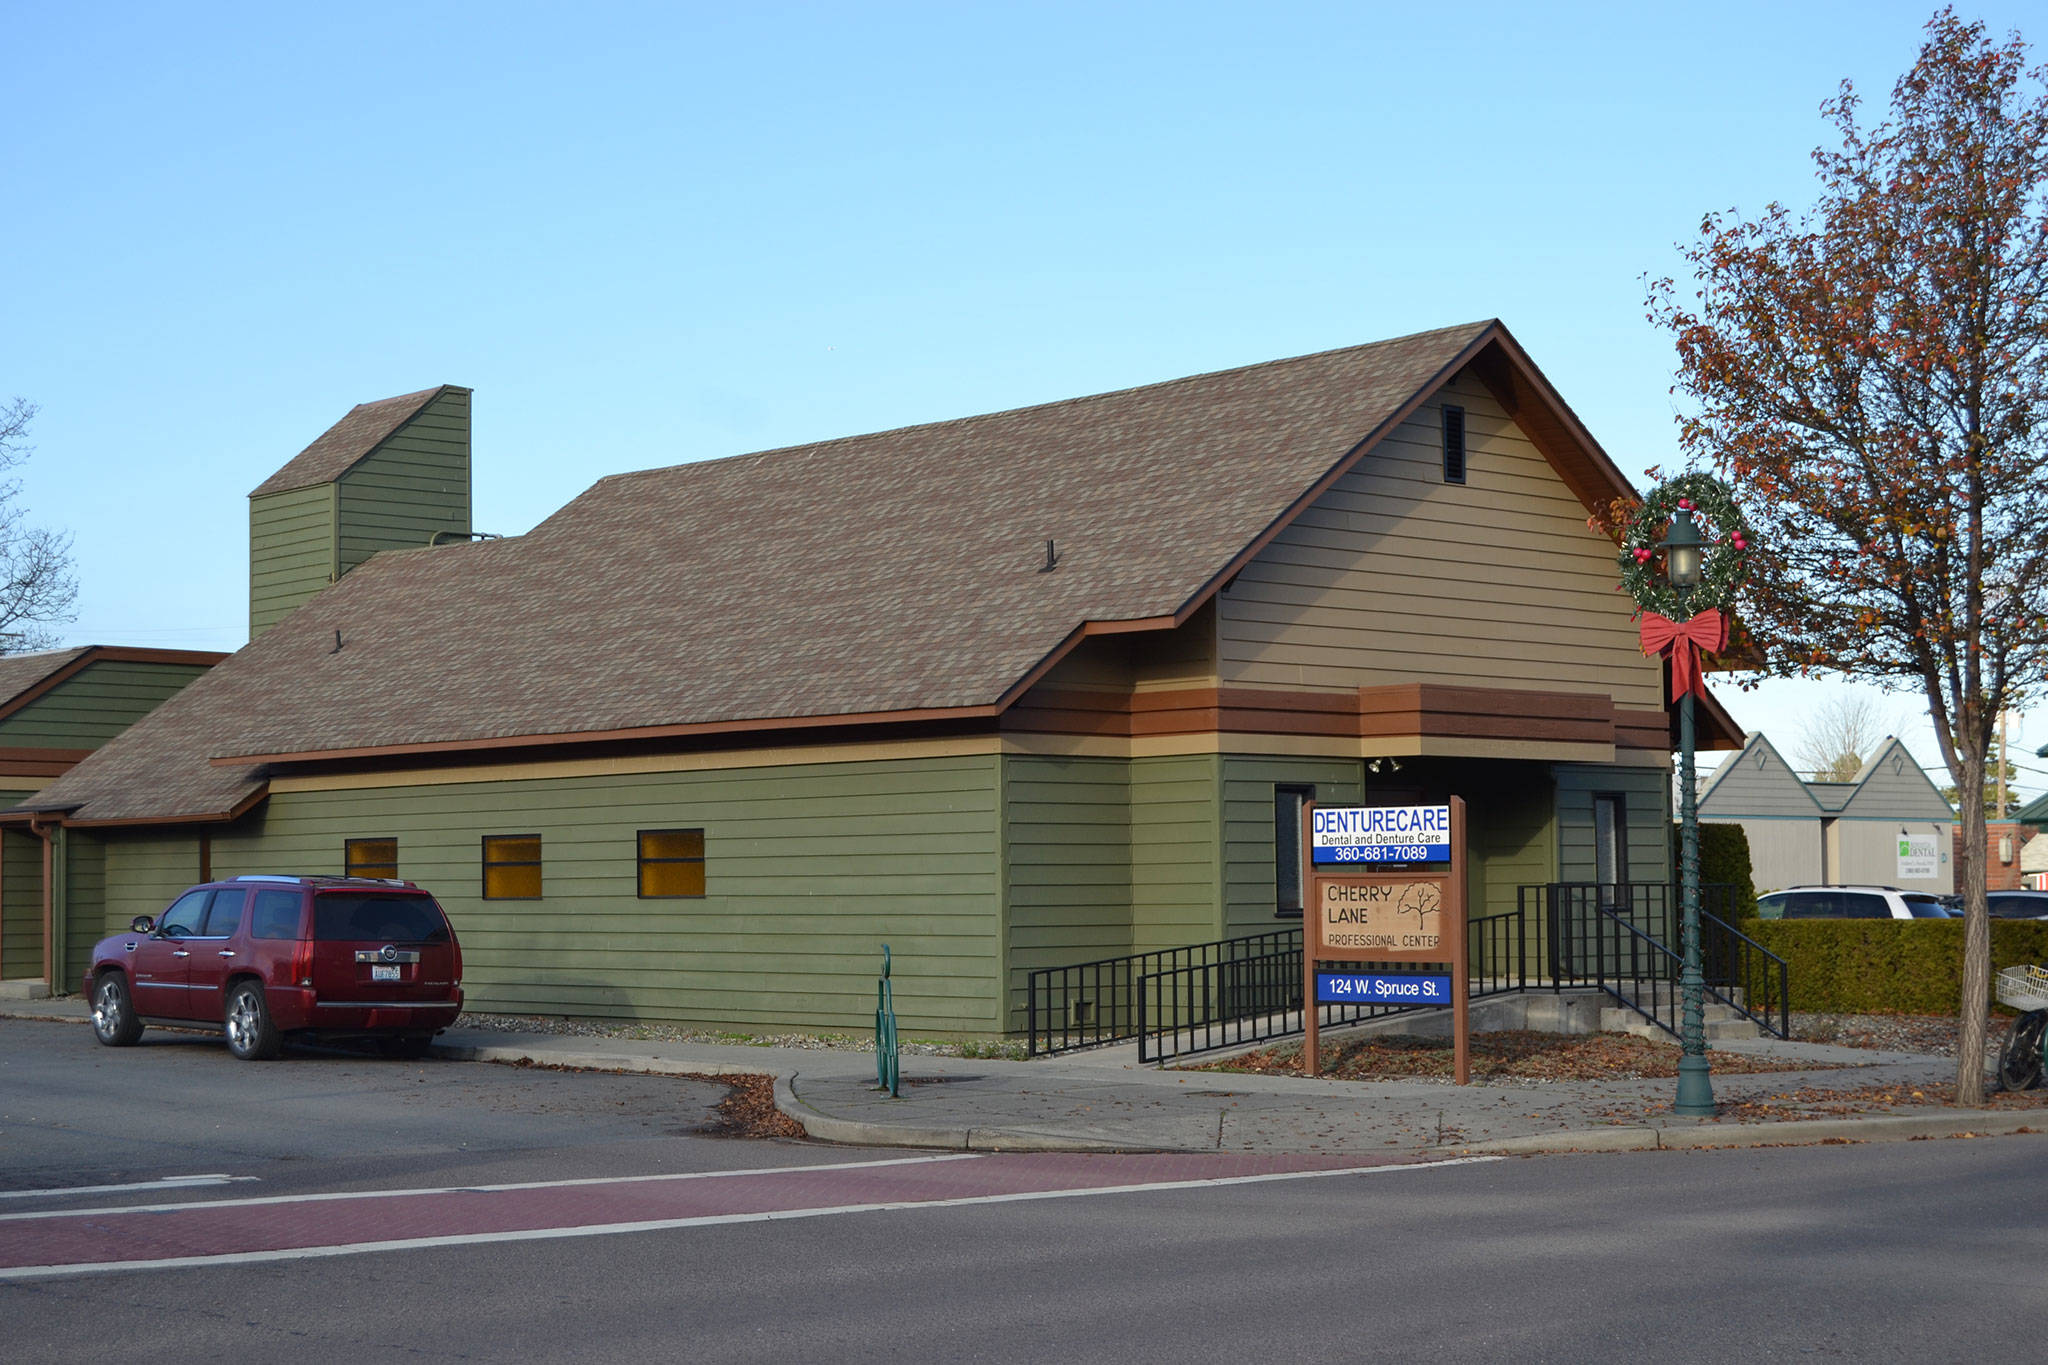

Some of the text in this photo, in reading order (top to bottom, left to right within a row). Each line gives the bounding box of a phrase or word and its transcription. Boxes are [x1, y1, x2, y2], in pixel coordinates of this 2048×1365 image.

[1314, 809, 1448, 833] DENTURECARE
[1321, 832, 1441, 845] Dental and Denture Care
[1335, 846, 1428, 861] 360-681-7089
[1910, 847, 1936, 857] DENTAL
[1327, 885, 1393, 902] CHERRY
[1328, 907, 1369, 924] LANE
[1328, 934, 1440, 947] PROFESSIONAL CENTER
[1329, 978, 1440, 998] 124 W. Spruce St.
